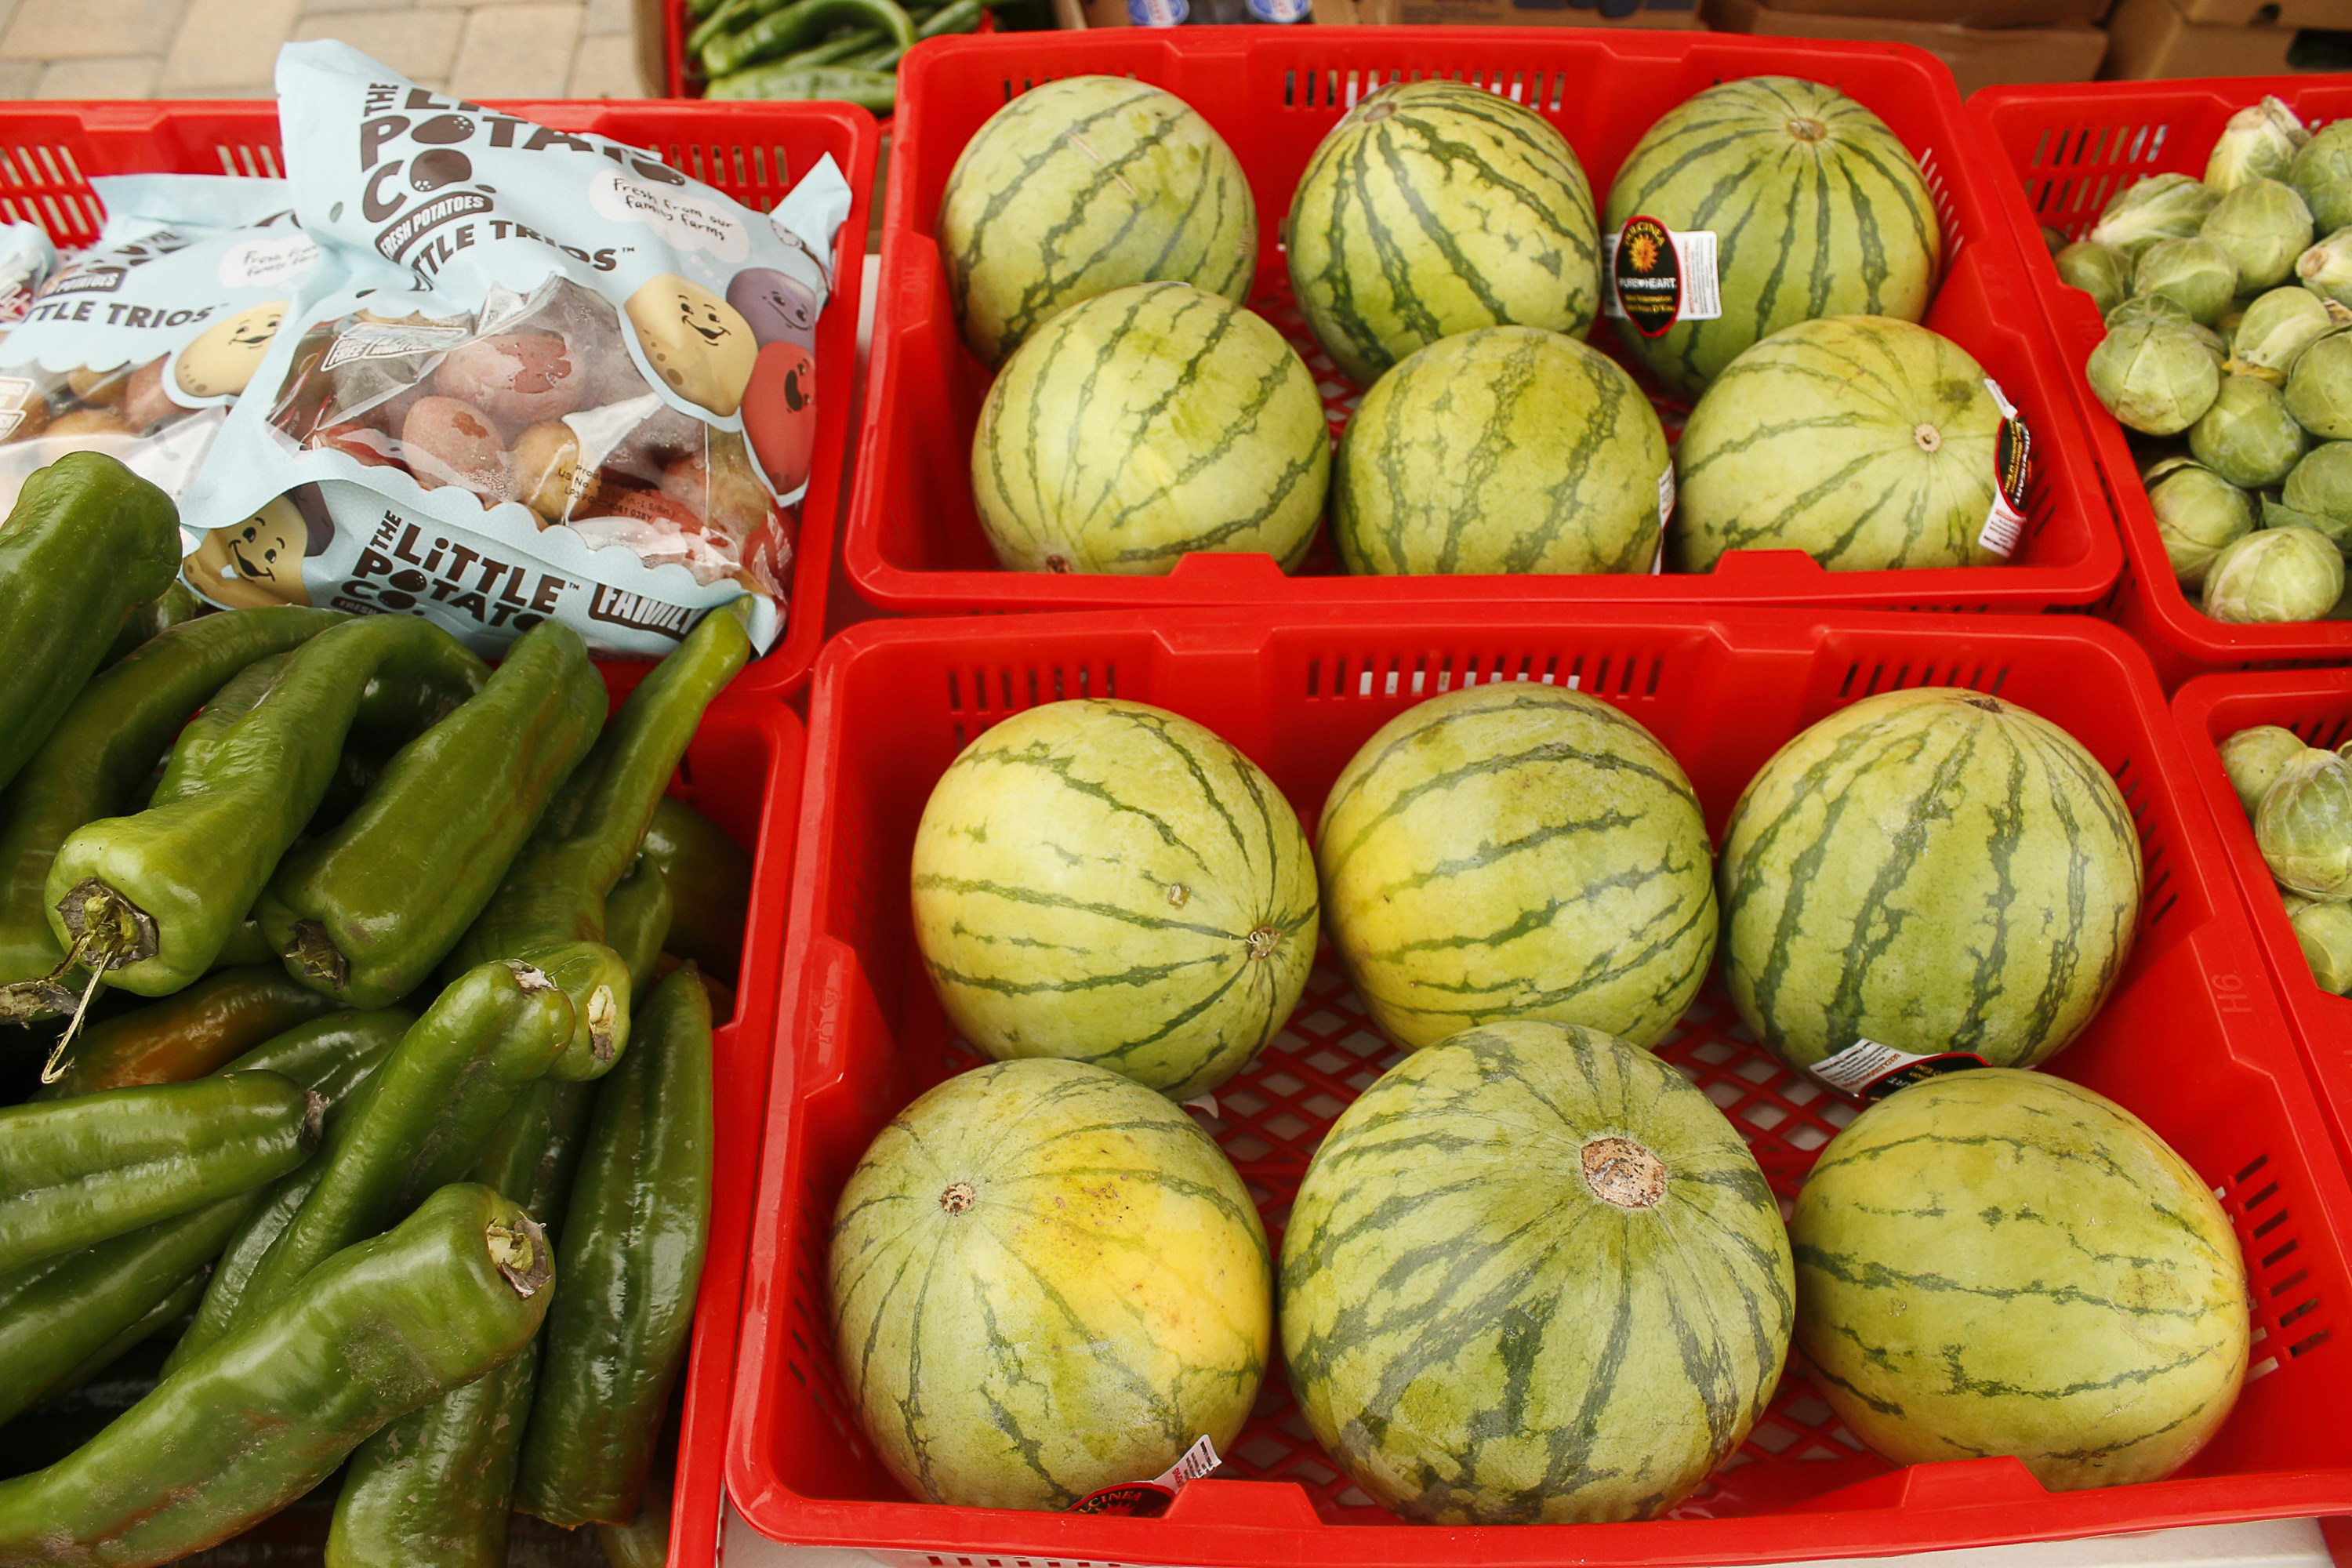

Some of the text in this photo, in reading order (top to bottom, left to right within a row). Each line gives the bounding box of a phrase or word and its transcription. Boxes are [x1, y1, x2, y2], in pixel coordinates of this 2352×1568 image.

[364, 82, 400, 118] THE
[614, 178, 733, 227] Fresh from our
[625, 194, 724, 241] family farms
[379, 195, 485, 260] FRESH POTATOES
[558, 468, 572, 481] US
[369, 509, 402, 550] THE
[1079, 1491, 1142, 1514] LCINEA
